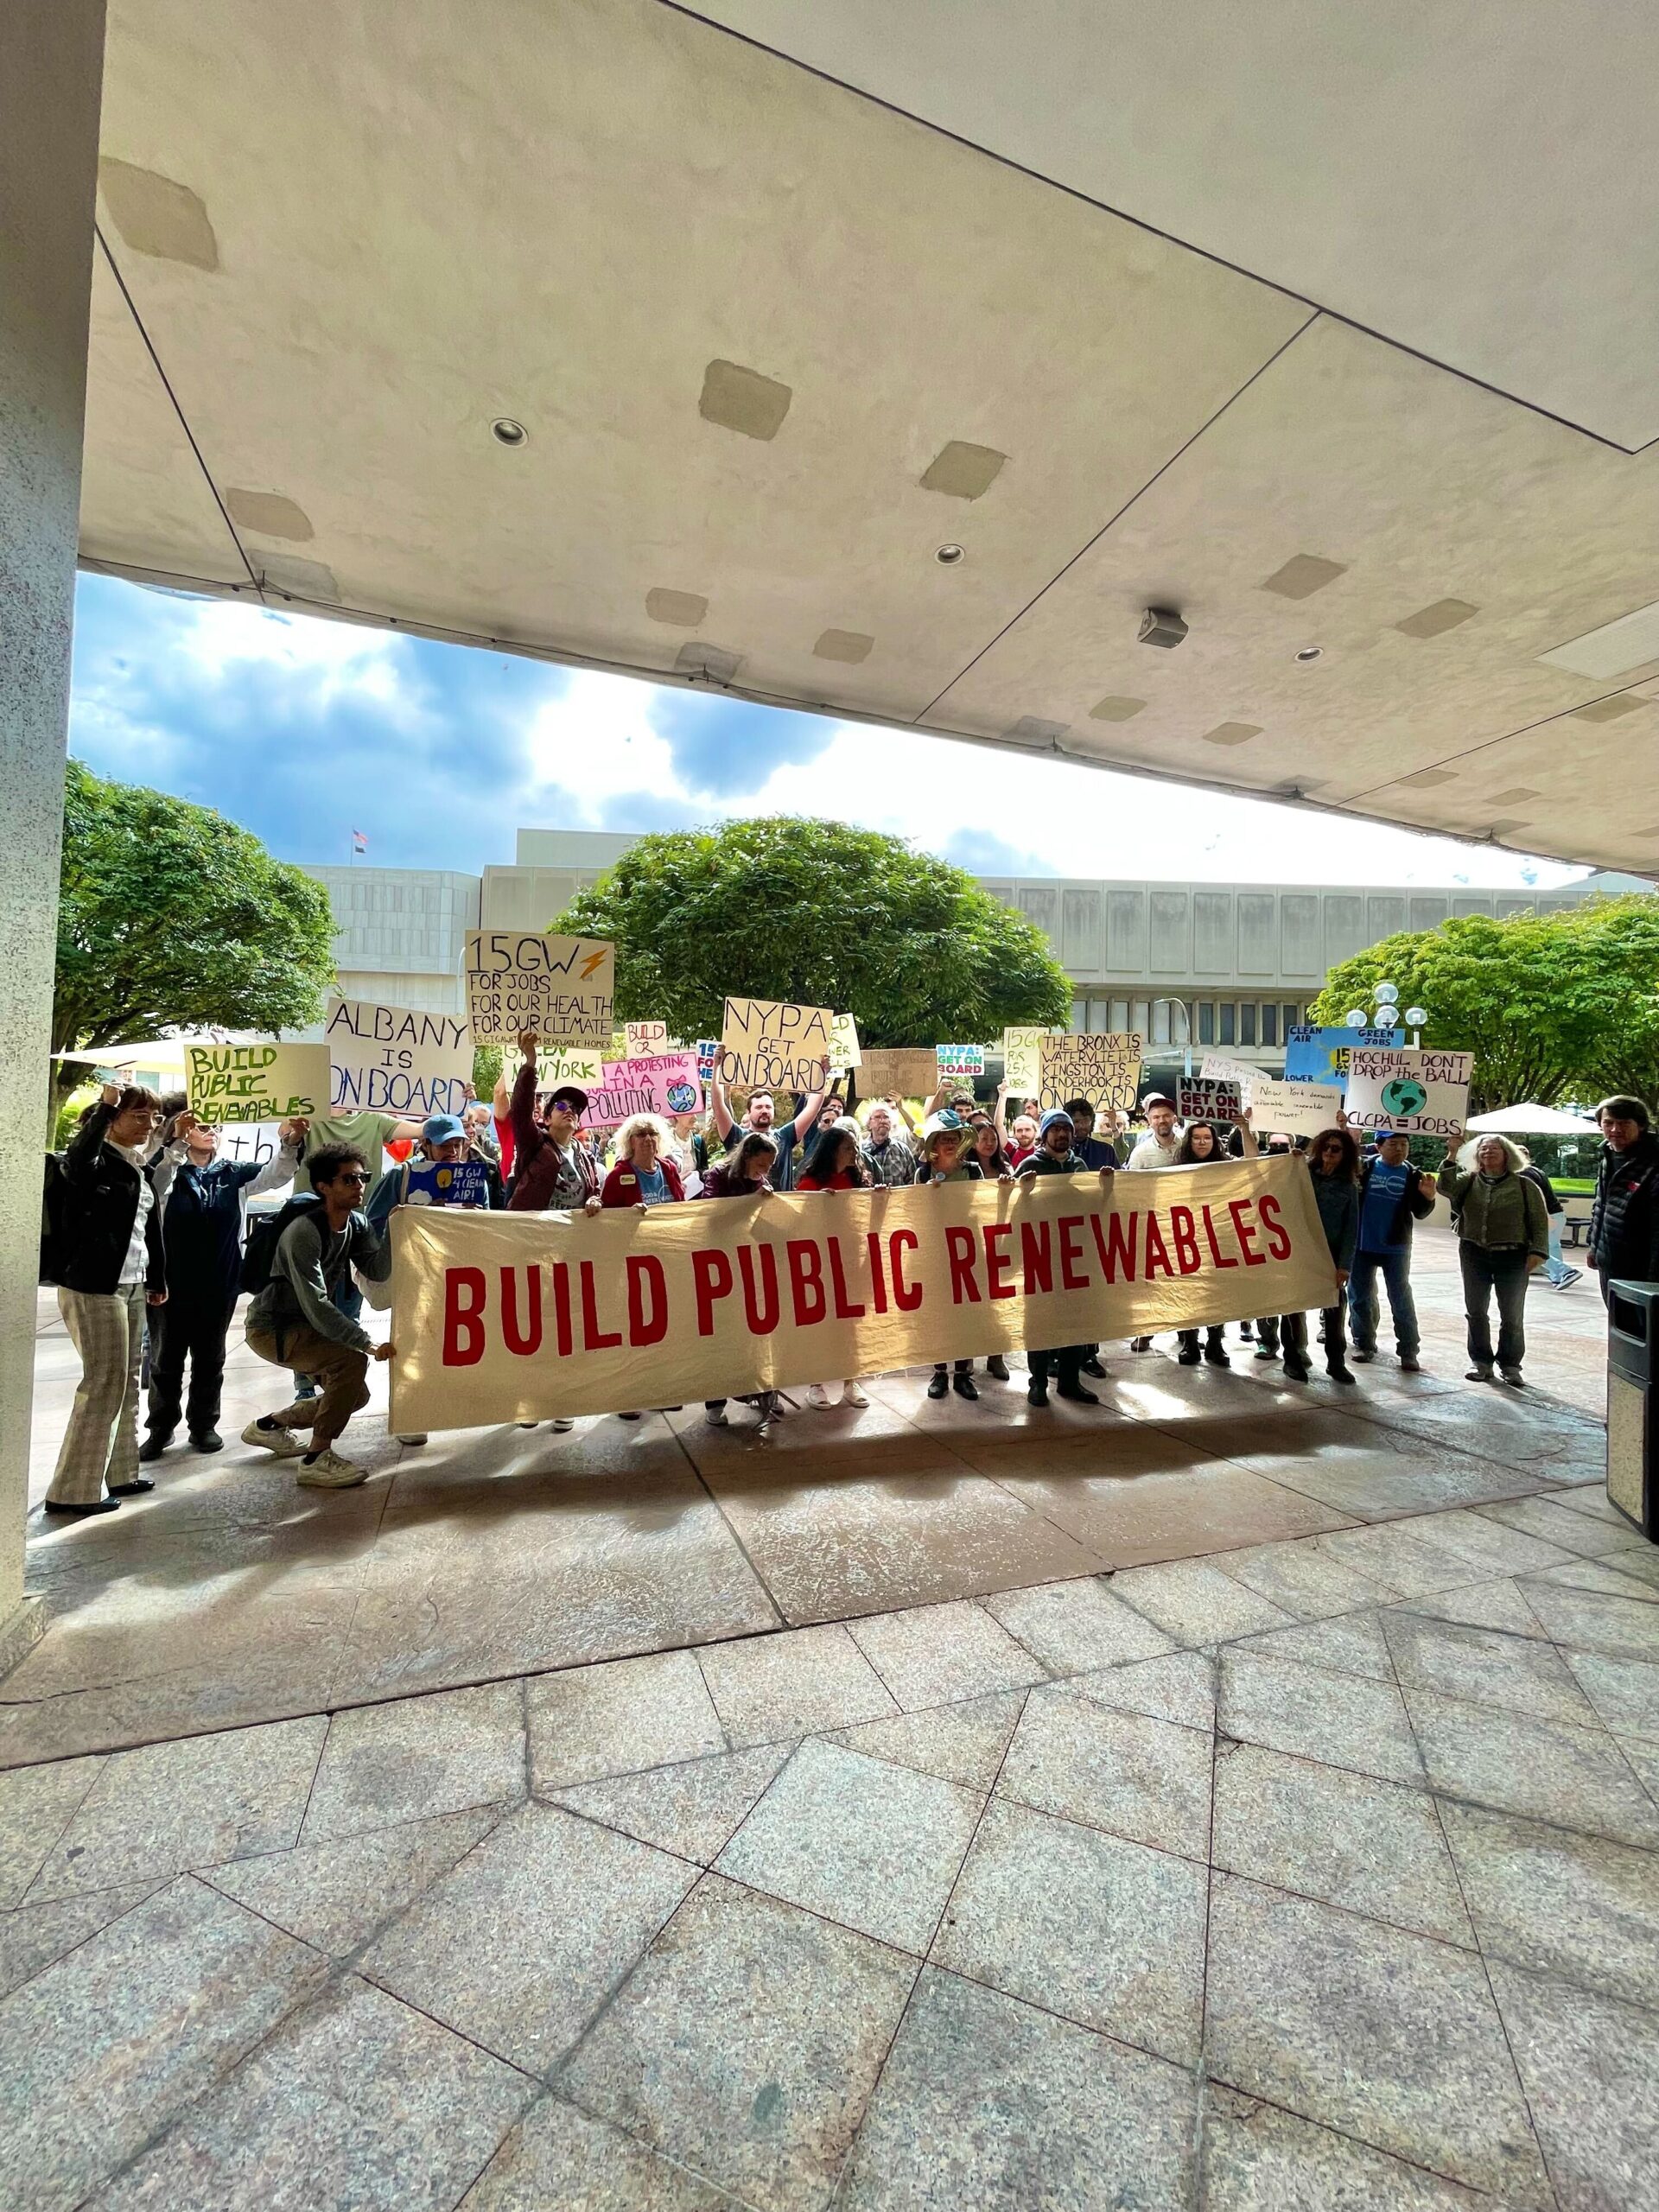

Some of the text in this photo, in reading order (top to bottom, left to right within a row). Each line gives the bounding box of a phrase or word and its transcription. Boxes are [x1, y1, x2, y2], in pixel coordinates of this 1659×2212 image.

[470, 974, 551, 994] FOR JOBS
[471, 994, 613, 1017] FOR OUR HEALTH
[327, 1003, 468, 1050] ALBANY
[473, 1014, 613, 1036] FOR OUR CLIMATE
[725, 999, 827, 1043] NYPA
[628, 1024, 664, 1043] BUILD
[1289, 1027, 1323, 1036] CLEAN
[1293, 1034, 1312, 1043] AIR
[1358, 1029, 1395, 1039] GREEN
[543, 1038, 581, 1047] RENEWABLE
[586, 1039, 611, 1048] HOMES
[635, 1041, 655, 1055] OR
[699, 1043, 716, 1058] 15
[758, 1037, 795, 1056] GET
[938, 1046, 980, 1055] NYPA:
[1043, 1033, 1141, 1052] THE BRONX IS
[1363, 1038, 1392, 1046] JOBS
[190, 1047, 278, 1073] BUILD
[380, 1048, 413, 1069] IS
[697, 1057, 715, 1068] FO
[938, 1055, 982, 1065] GET ON
[1007, 1051, 1025, 1062] FOR
[1042, 1049, 1141, 1064] WATERVLIET IS
[1336, 1048, 1351, 1063] 15
[1352, 1052, 1468, 1069] HOCHUL DON'T
[550, 1059, 596, 1080] YORK
[627, 1056, 689, 1076] PROTESTING
[1042, 1063, 1127, 1077] KINGSTON IS
[1207, 1058, 1232, 1071] NYS
[1042, 1074, 1132, 1088] KINDERHOOK IS
[1285, 1074, 1314, 1083] LOWER
[1334, 1070, 1346, 1078] FO
[1353, 1064, 1470, 1086] DROP the BALL
[191, 1074, 268, 1098] PUBLIC
[609, 1076, 634, 1092] IN
[639, 1074, 654, 1088] A
[1180, 1077, 1234, 1095] NYPA:
[1259, 1086, 1281, 1096] New
[367, 1068, 469, 1118] BOARD
[1039, 1087, 1067, 1111] ON
[1180, 1091, 1211, 1106] GET
[1215, 1095, 1238, 1108] ON
[191, 1096, 315, 1123] RENEWABLES
[587, 1088, 662, 1123] POLLUTING
[1180, 1104, 1241, 1121] BOARD
[1347, 1110, 1393, 1129] CLCPA
[1409, 1116, 1463, 1136] JOBS
[453, 1167, 481, 1179] 15 GW
[453, 1179, 461, 1189] 4
[453, 1189, 475, 1200] AIR!
[442, 1194, 1293, 1367] BUILD PUBLIC RENEWABLES
